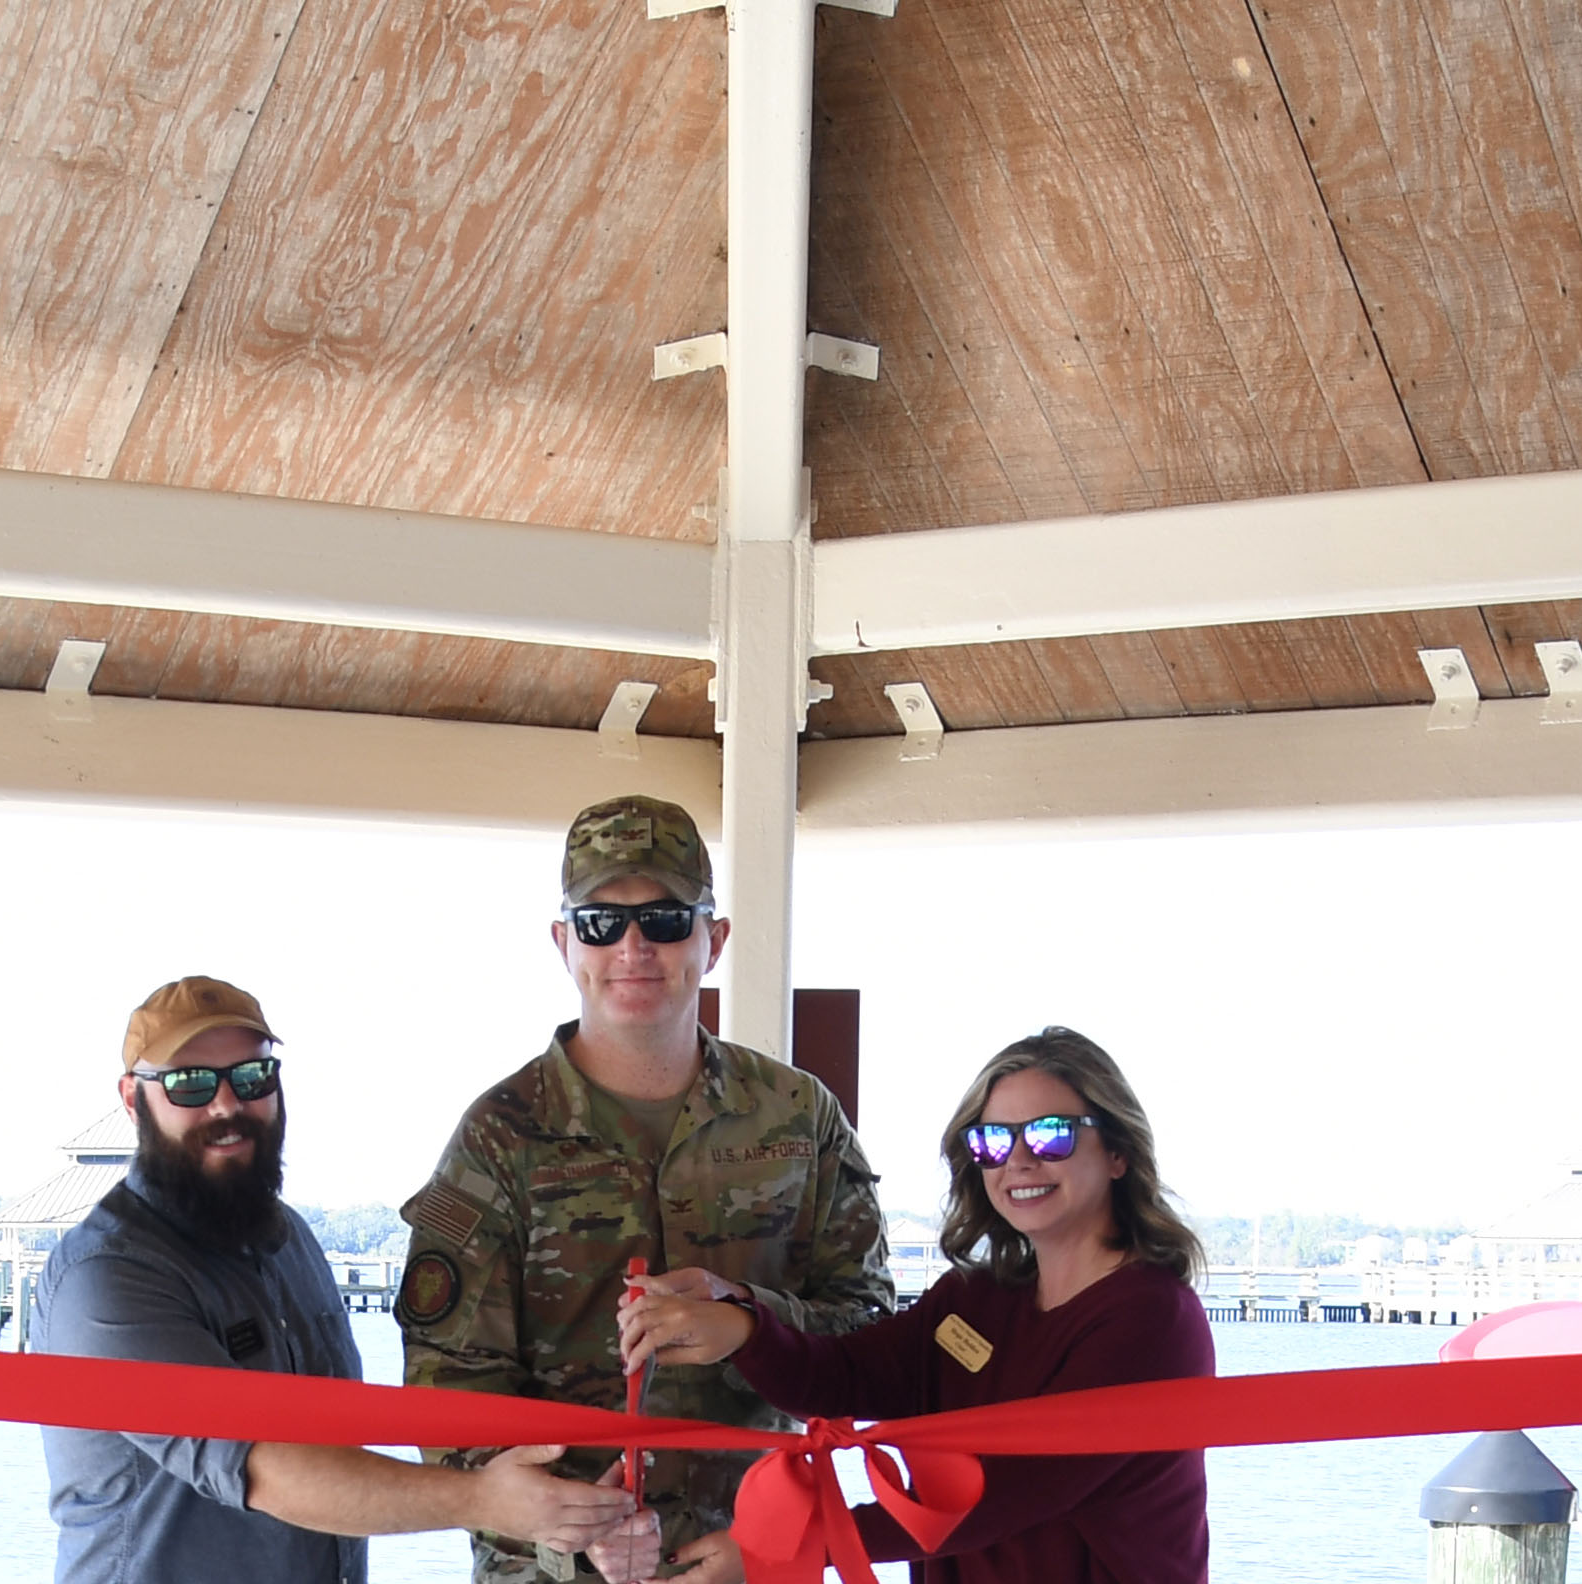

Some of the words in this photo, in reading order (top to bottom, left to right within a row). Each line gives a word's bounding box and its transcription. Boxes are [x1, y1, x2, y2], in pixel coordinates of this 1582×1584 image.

[711, 1147, 740, 1164] U.S.
[744, 1145, 767, 1162] AIR
[770, 1141, 812, 1159] FORCE
